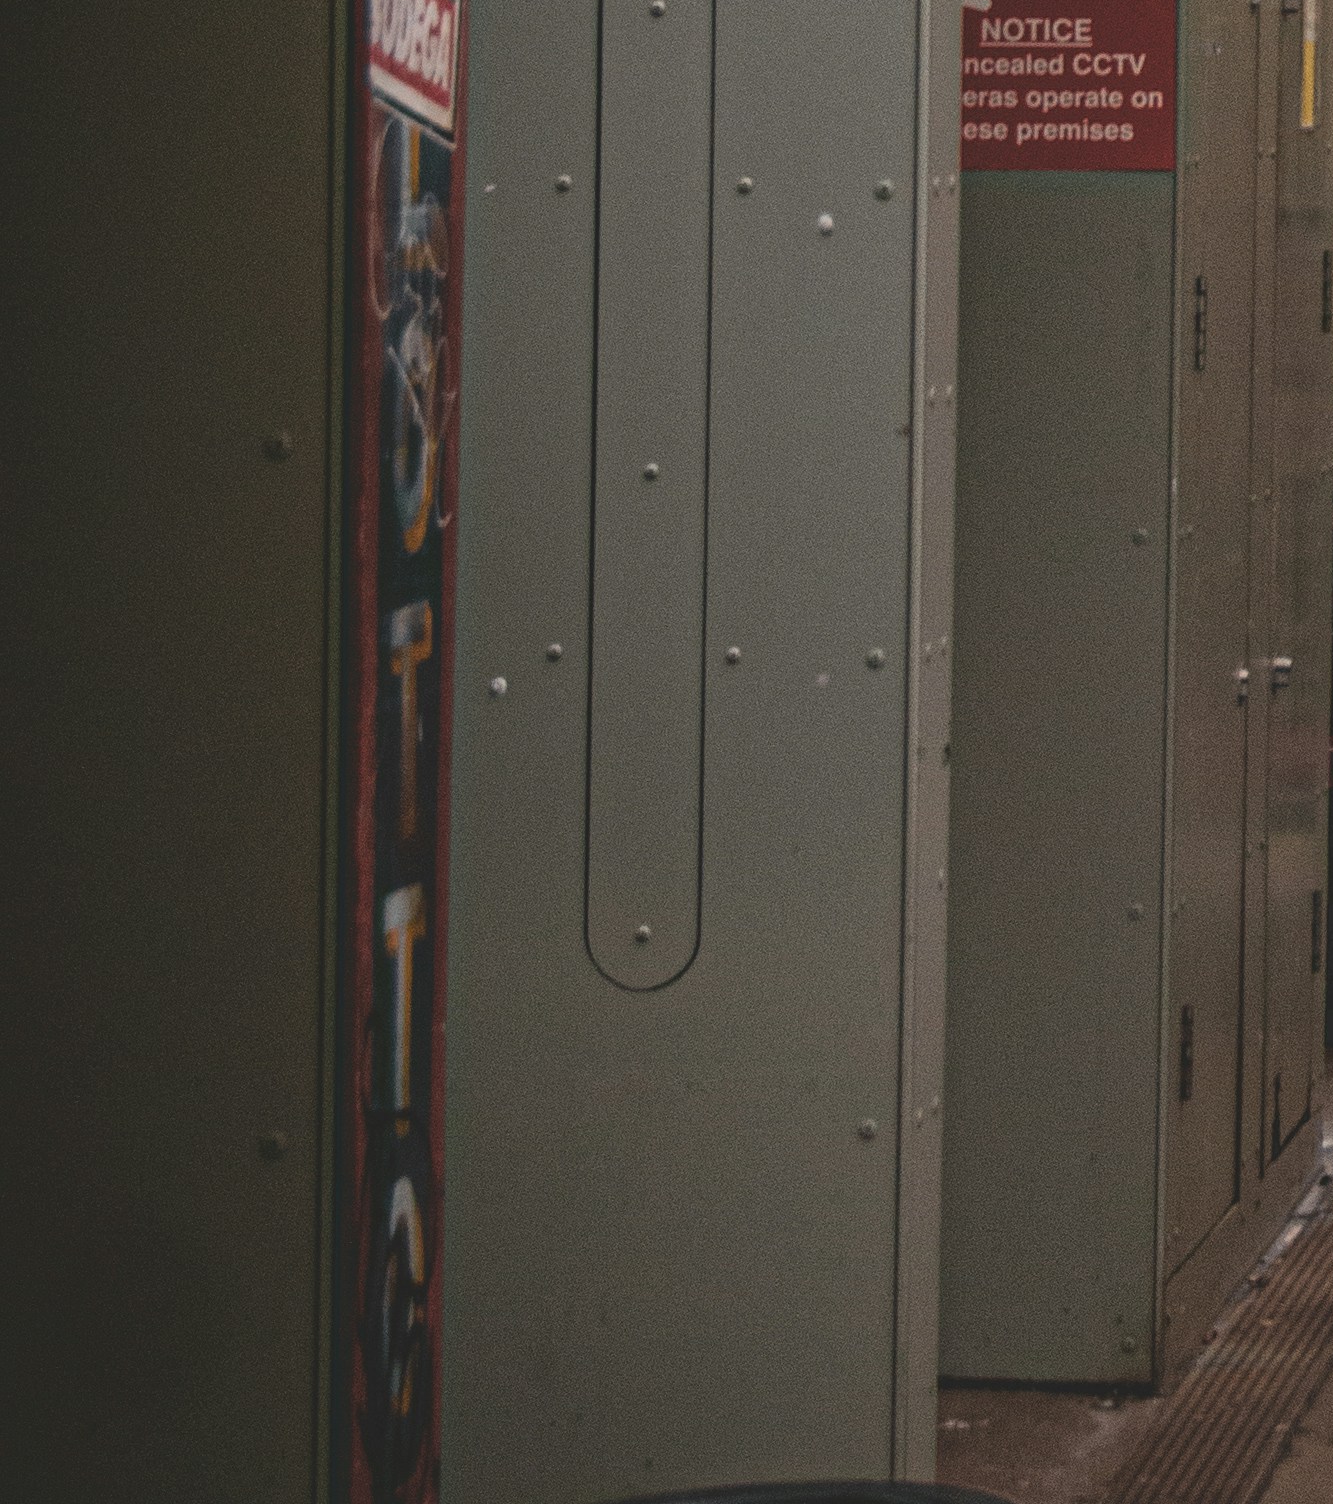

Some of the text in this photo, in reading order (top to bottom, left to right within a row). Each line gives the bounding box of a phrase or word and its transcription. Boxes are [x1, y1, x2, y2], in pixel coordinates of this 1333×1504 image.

[981, 17, 1093, 44] NOTICE
[1072, 54, 1146, 75] CCTV
[1025, 88, 1123, 112] operate
[1130, 91, 1163, 108] on
[1016, 120, 1134, 145] premises
